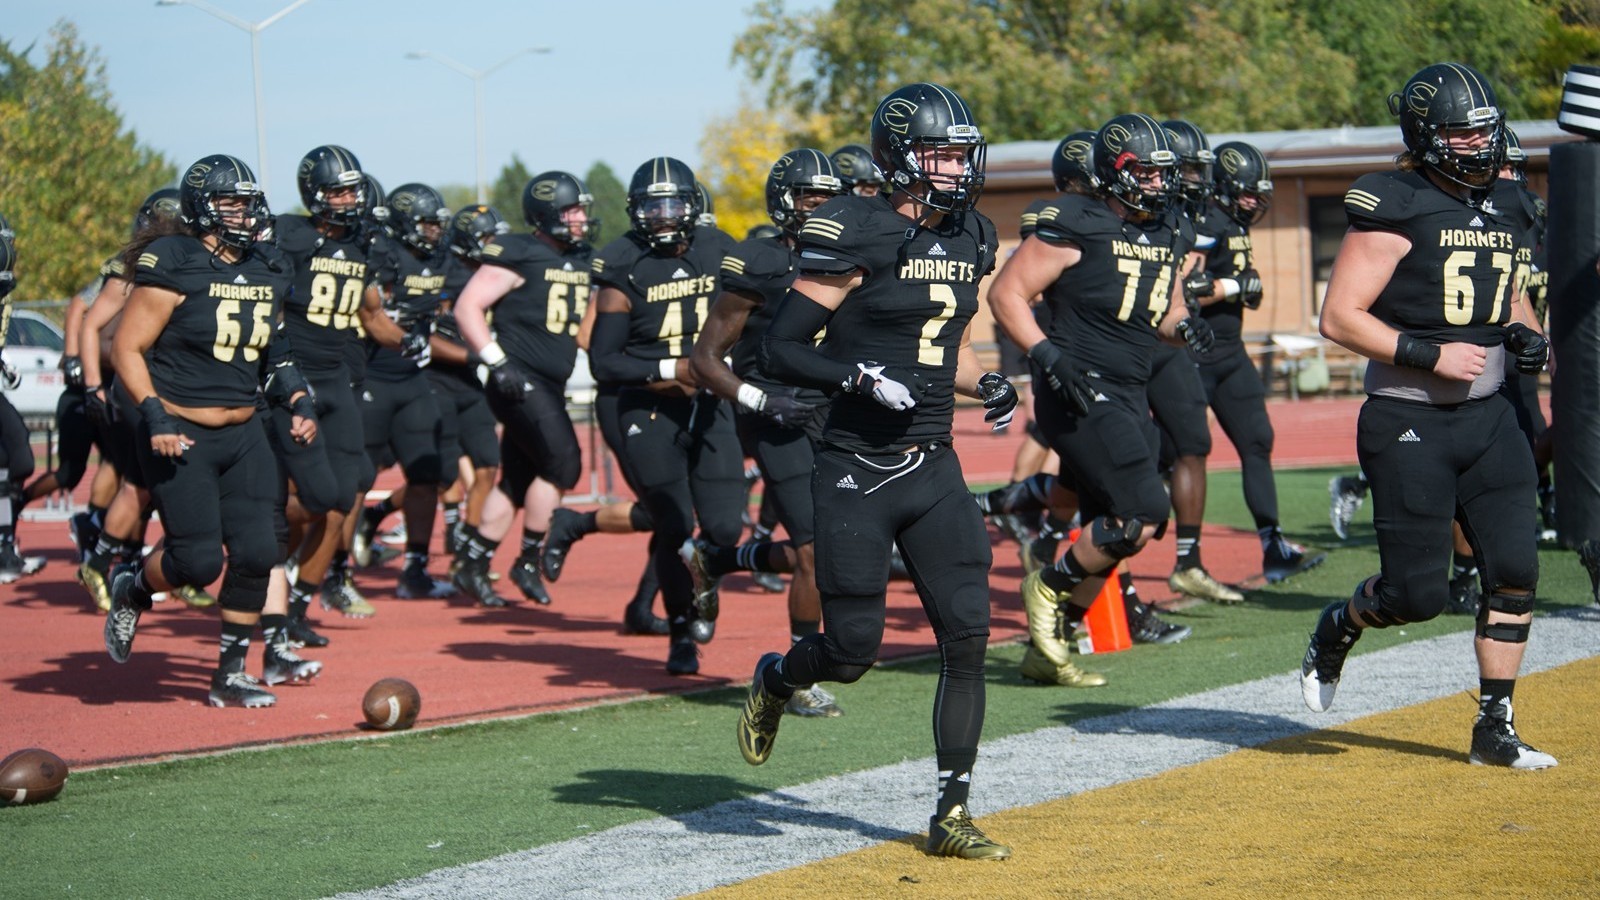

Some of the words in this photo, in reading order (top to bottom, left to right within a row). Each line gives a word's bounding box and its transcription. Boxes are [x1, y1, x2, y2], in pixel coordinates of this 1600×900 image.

[1112, 240, 1174, 263] HORNETS
[1440, 229, 1513, 249] HORNETS
[309, 257, 366, 279] HORNETS
[544, 268, 590, 285] HORNETS
[900, 258, 976, 282] HORNETS
[208, 282, 274, 300] HORNETS
[646, 275, 716, 303] HORNETS
[1117, 258, 1172, 328] 74
[1444, 251, 1513, 325] 67
[306, 273, 366, 338] 80
[212, 299, 273, 363] 66
[917, 283, 957, 366] 2
